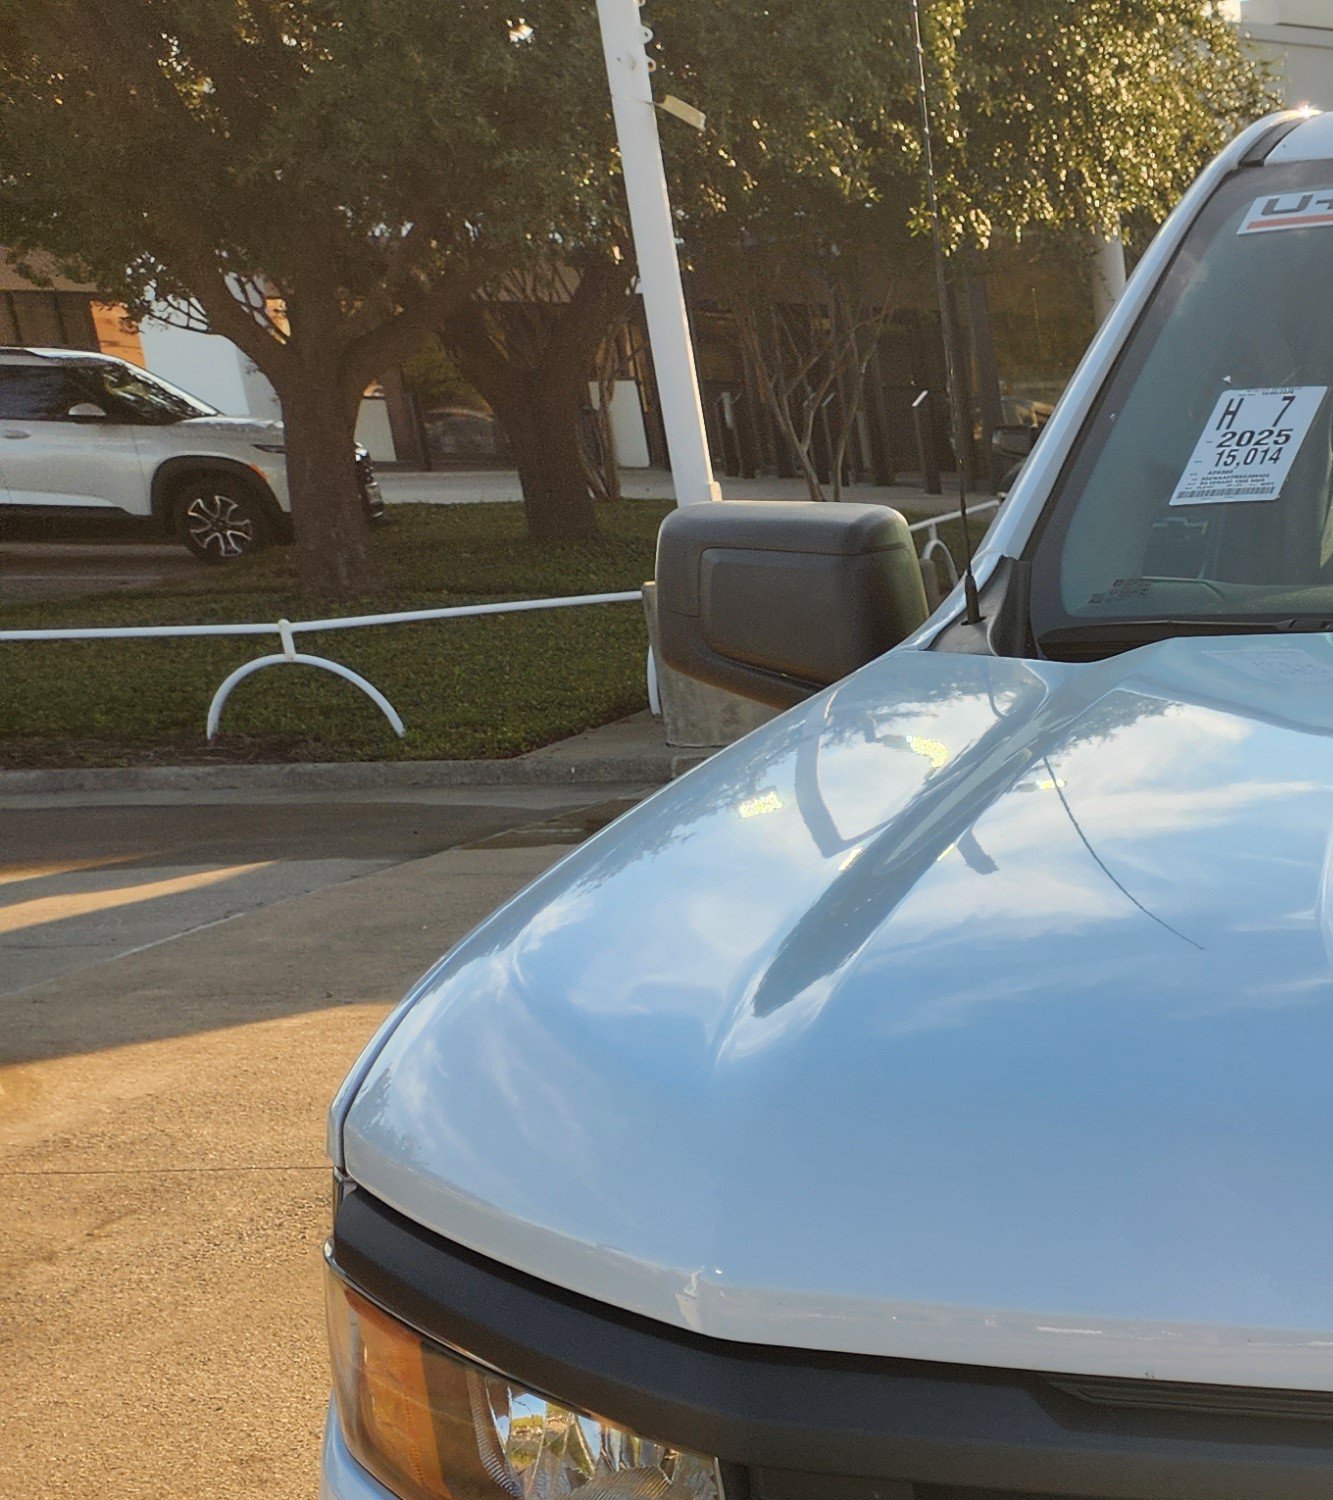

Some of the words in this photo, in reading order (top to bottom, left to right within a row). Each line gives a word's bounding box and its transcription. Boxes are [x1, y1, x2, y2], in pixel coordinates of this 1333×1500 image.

[1216, 397, 1245, 431] H
[1272, 395, 1296, 428] 7
[1215, 428, 1294, 449] 2025
[1214, 447, 1283, 469] 15,014
